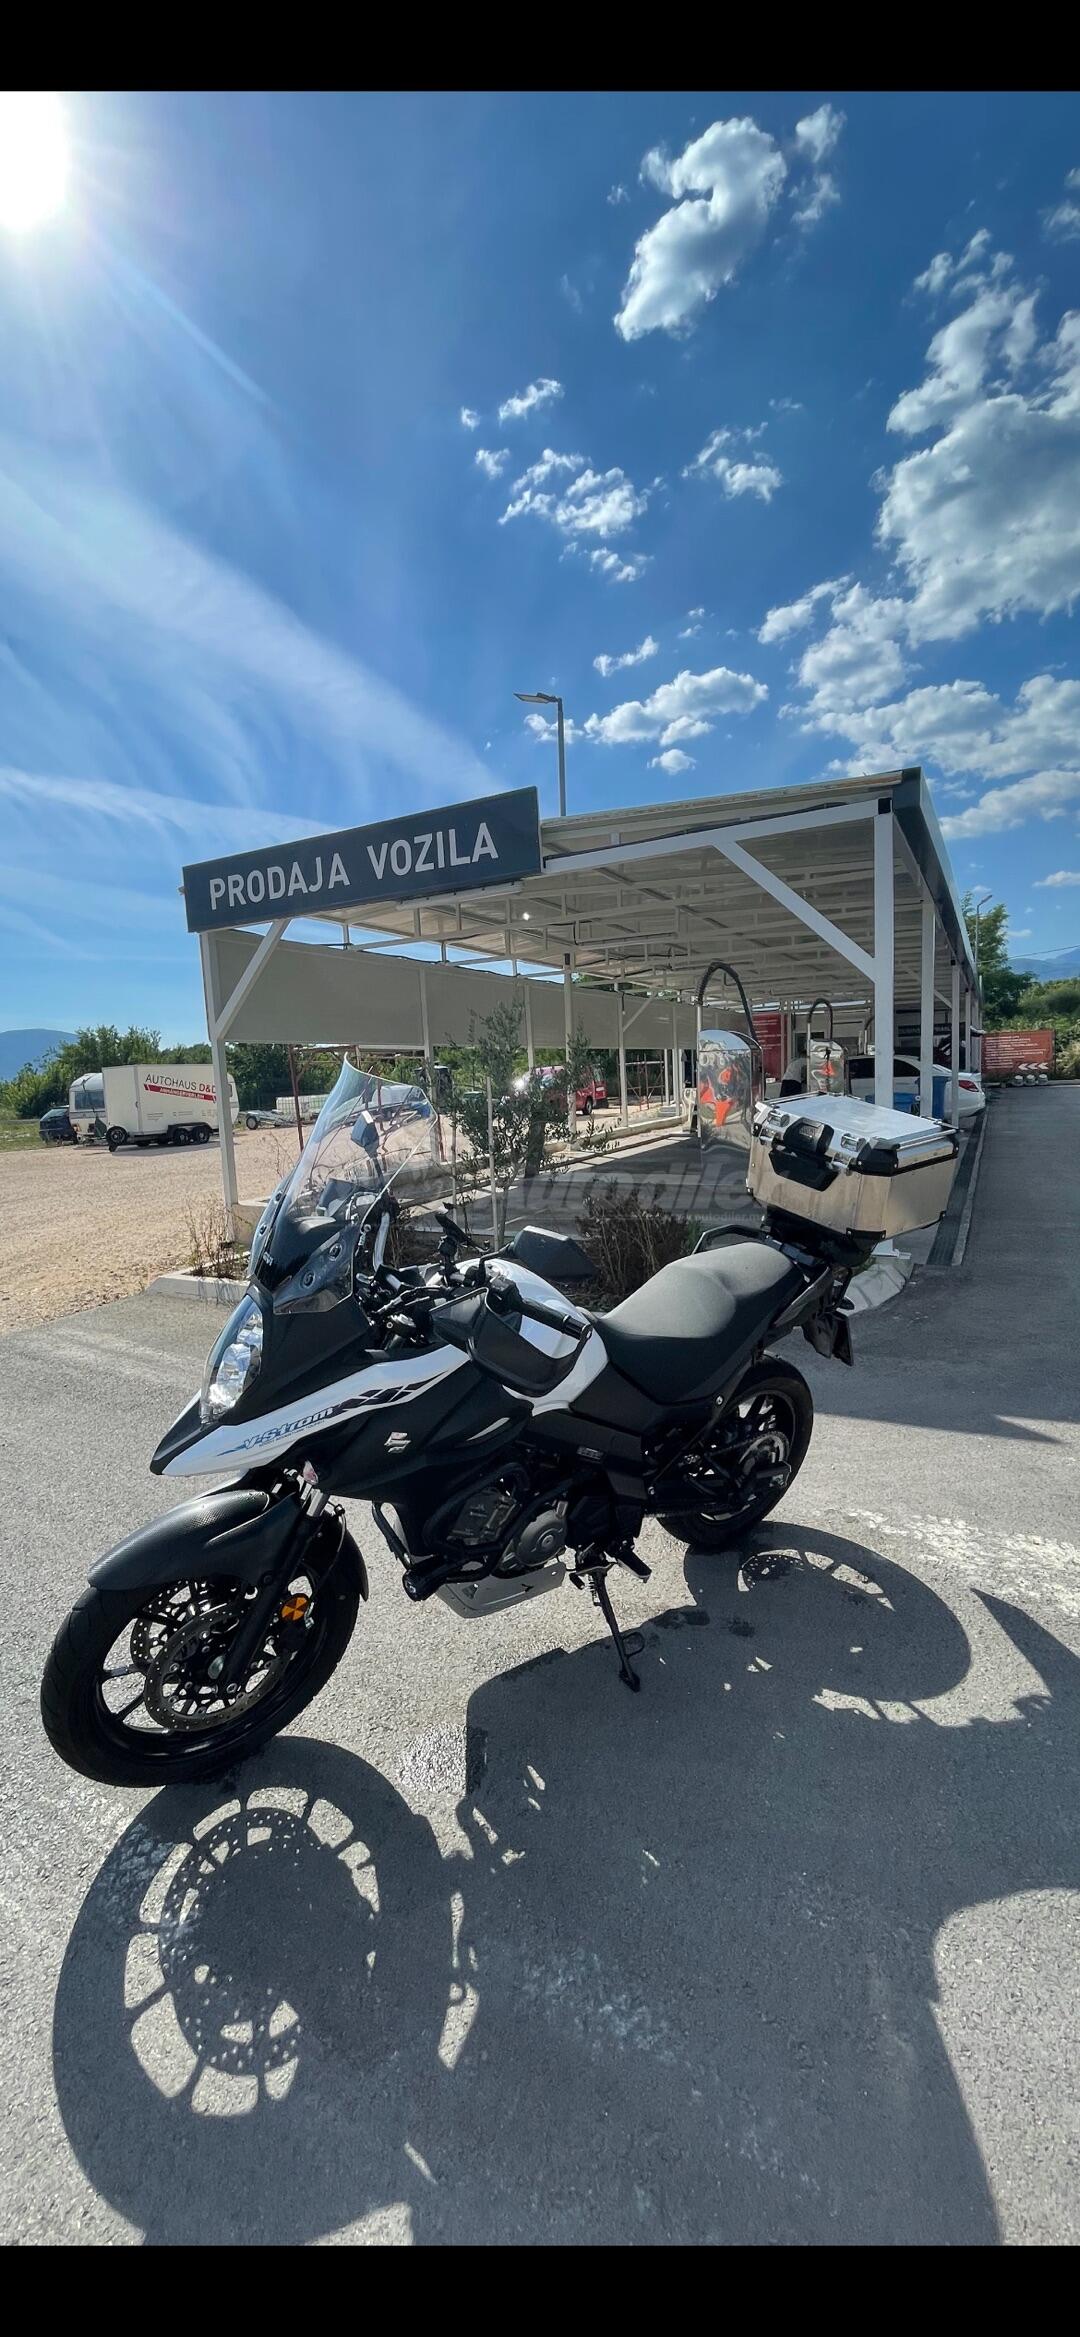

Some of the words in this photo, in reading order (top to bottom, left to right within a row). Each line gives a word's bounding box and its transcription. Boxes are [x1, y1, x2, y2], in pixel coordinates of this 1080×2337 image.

[209, 852, 350, 911] PRODAJA
[367, 822, 499, 880] VOZILA
[145, 1073, 197, 1091] AUTOHAUS
[243, 1405, 335, 1449] V-Strom
